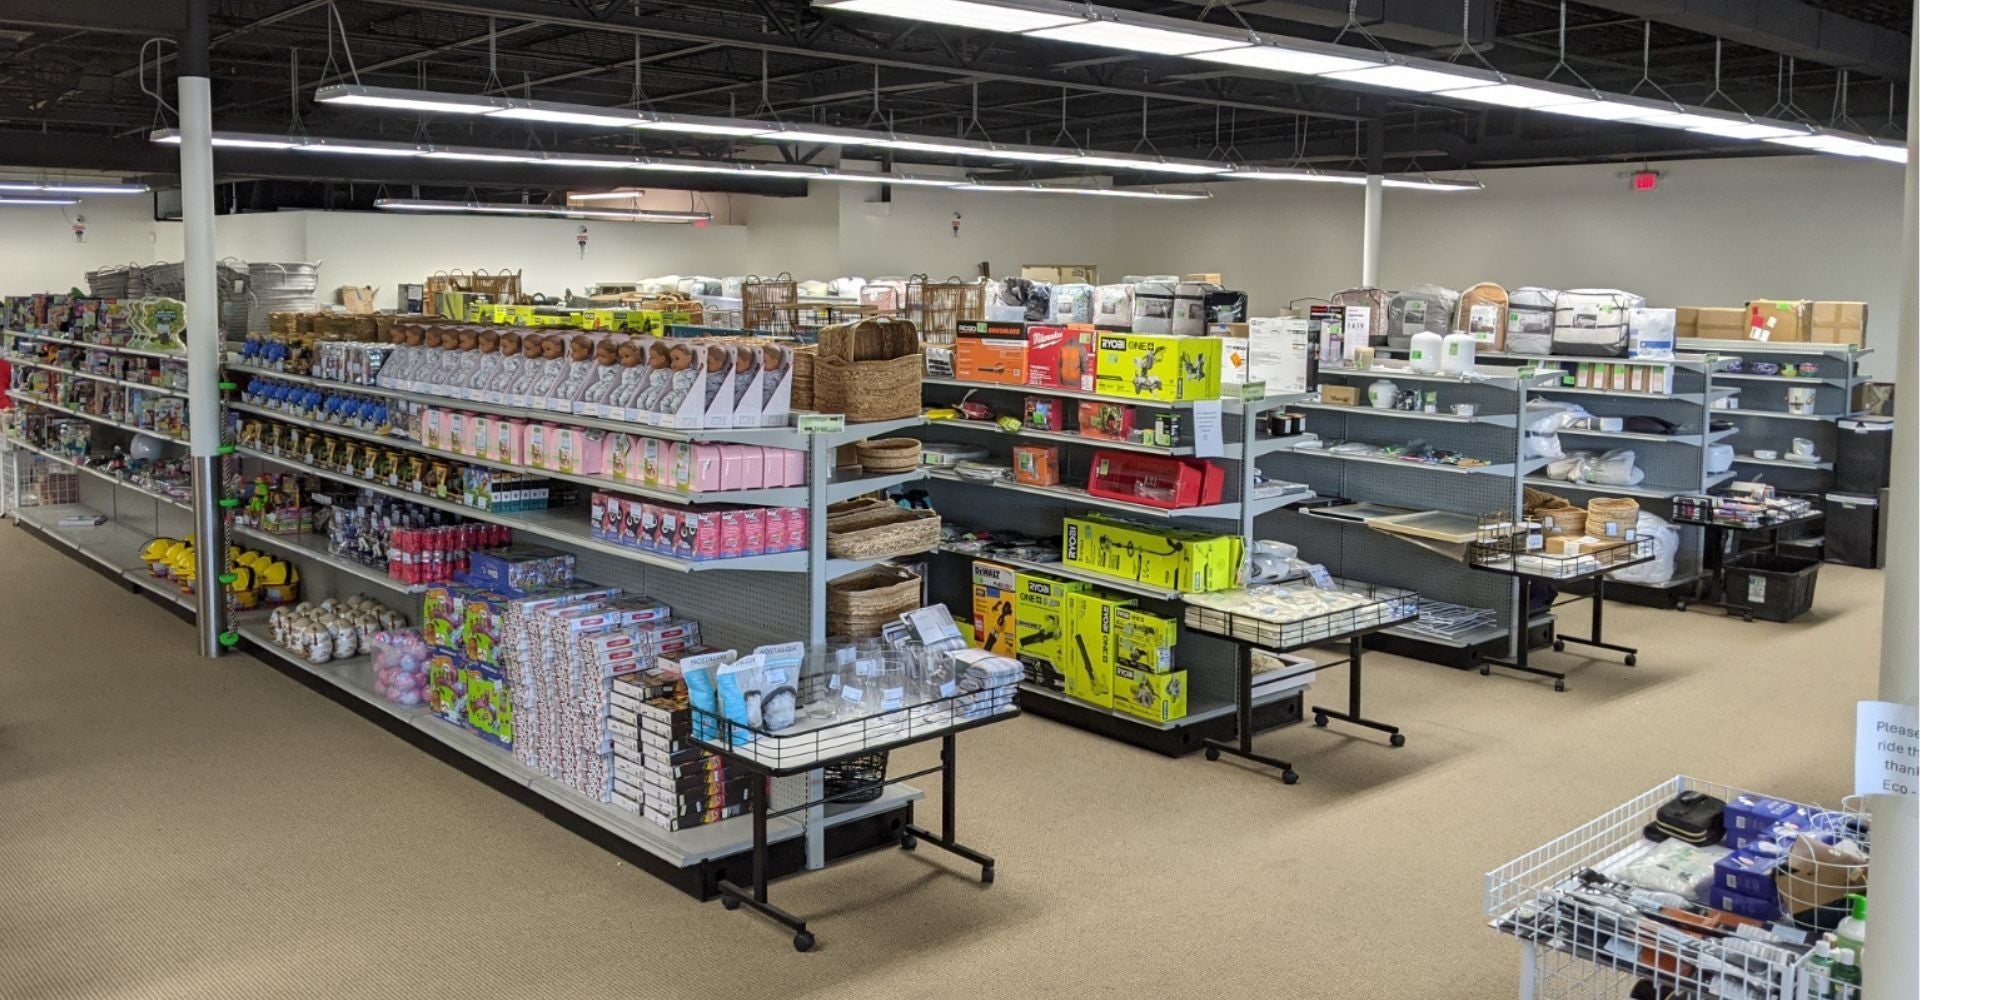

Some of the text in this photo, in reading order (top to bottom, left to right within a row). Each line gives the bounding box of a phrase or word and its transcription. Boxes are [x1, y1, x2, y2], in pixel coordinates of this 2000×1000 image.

[1101, 339, 1126, 350] RYOBI
[1068, 526, 1078, 560] RYOBI
[1029, 582, 1051, 595] RYOBI
[1876, 721, 1919, 739] Please
[1877, 741, 1904, 754] ride
[1882, 779, 1908, 794] Eco
